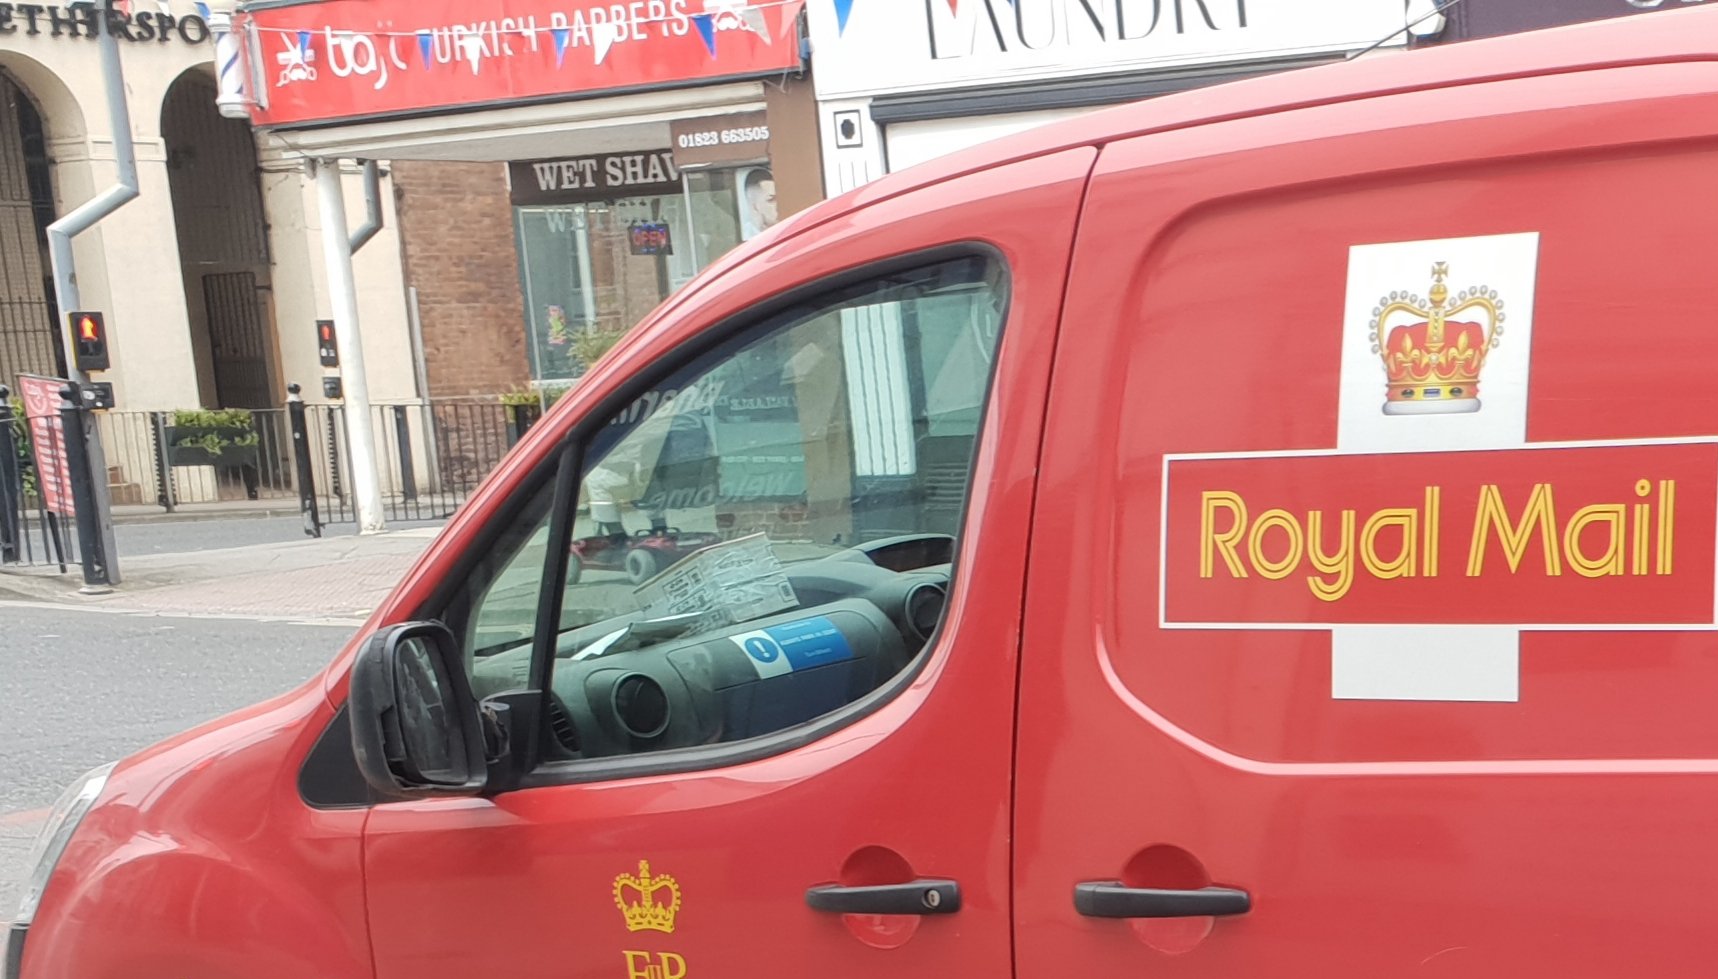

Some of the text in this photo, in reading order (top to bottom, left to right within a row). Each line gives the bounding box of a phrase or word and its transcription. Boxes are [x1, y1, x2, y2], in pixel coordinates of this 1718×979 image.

[679, 126, 769, 148] 01823 663505
[533, 158, 598, 191] WET
[631, 231, 667, 246] OPEN
[1200, 479, 1675, 601] Royal Mail
